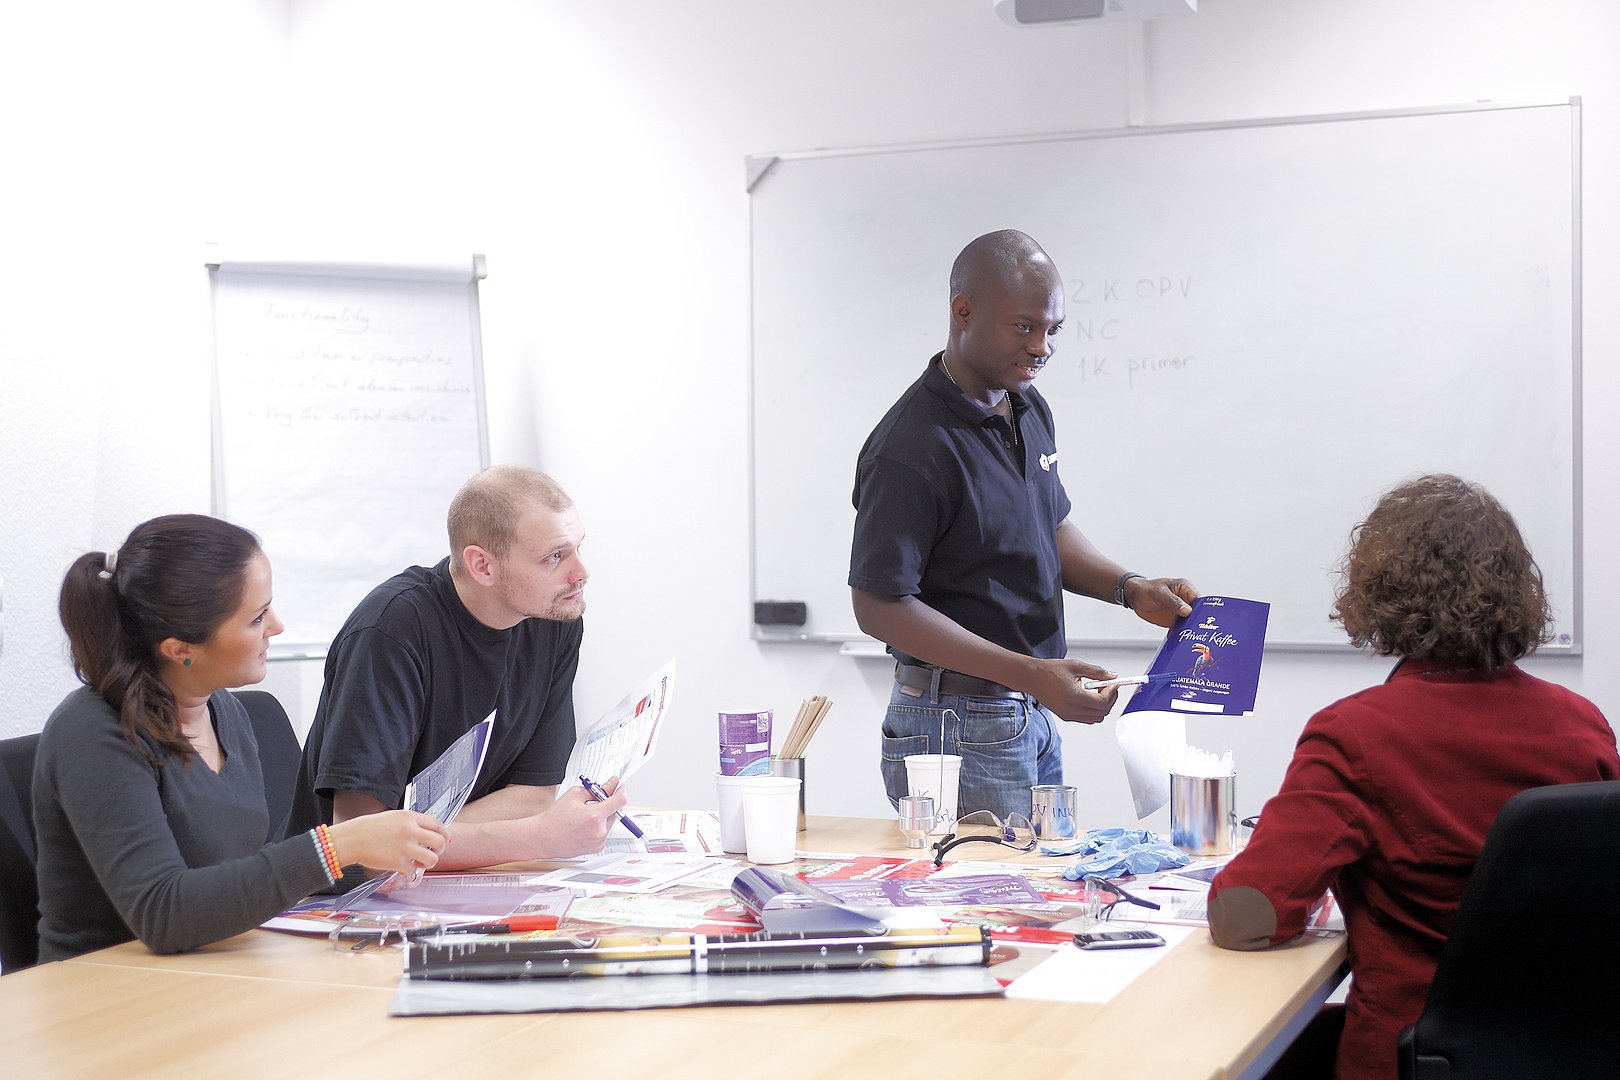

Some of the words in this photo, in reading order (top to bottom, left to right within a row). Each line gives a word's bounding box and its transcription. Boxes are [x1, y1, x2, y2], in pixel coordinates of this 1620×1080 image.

[1135, 275, 1192, 298] OPV
[1076, 318, 1119, 341] NC
[1078, 355, 1112, 381] 1K
[1127, 354, 1195, 389] primer
[1178, 629, 1208, 643] Privat
[1209, 632, 1239, 647] Kaffee
[1172, 677, 1206, 687] UATEMALA
[1206, 680, 1231, 690] GRANDE
[1052, 807, 1074, 818] INK
